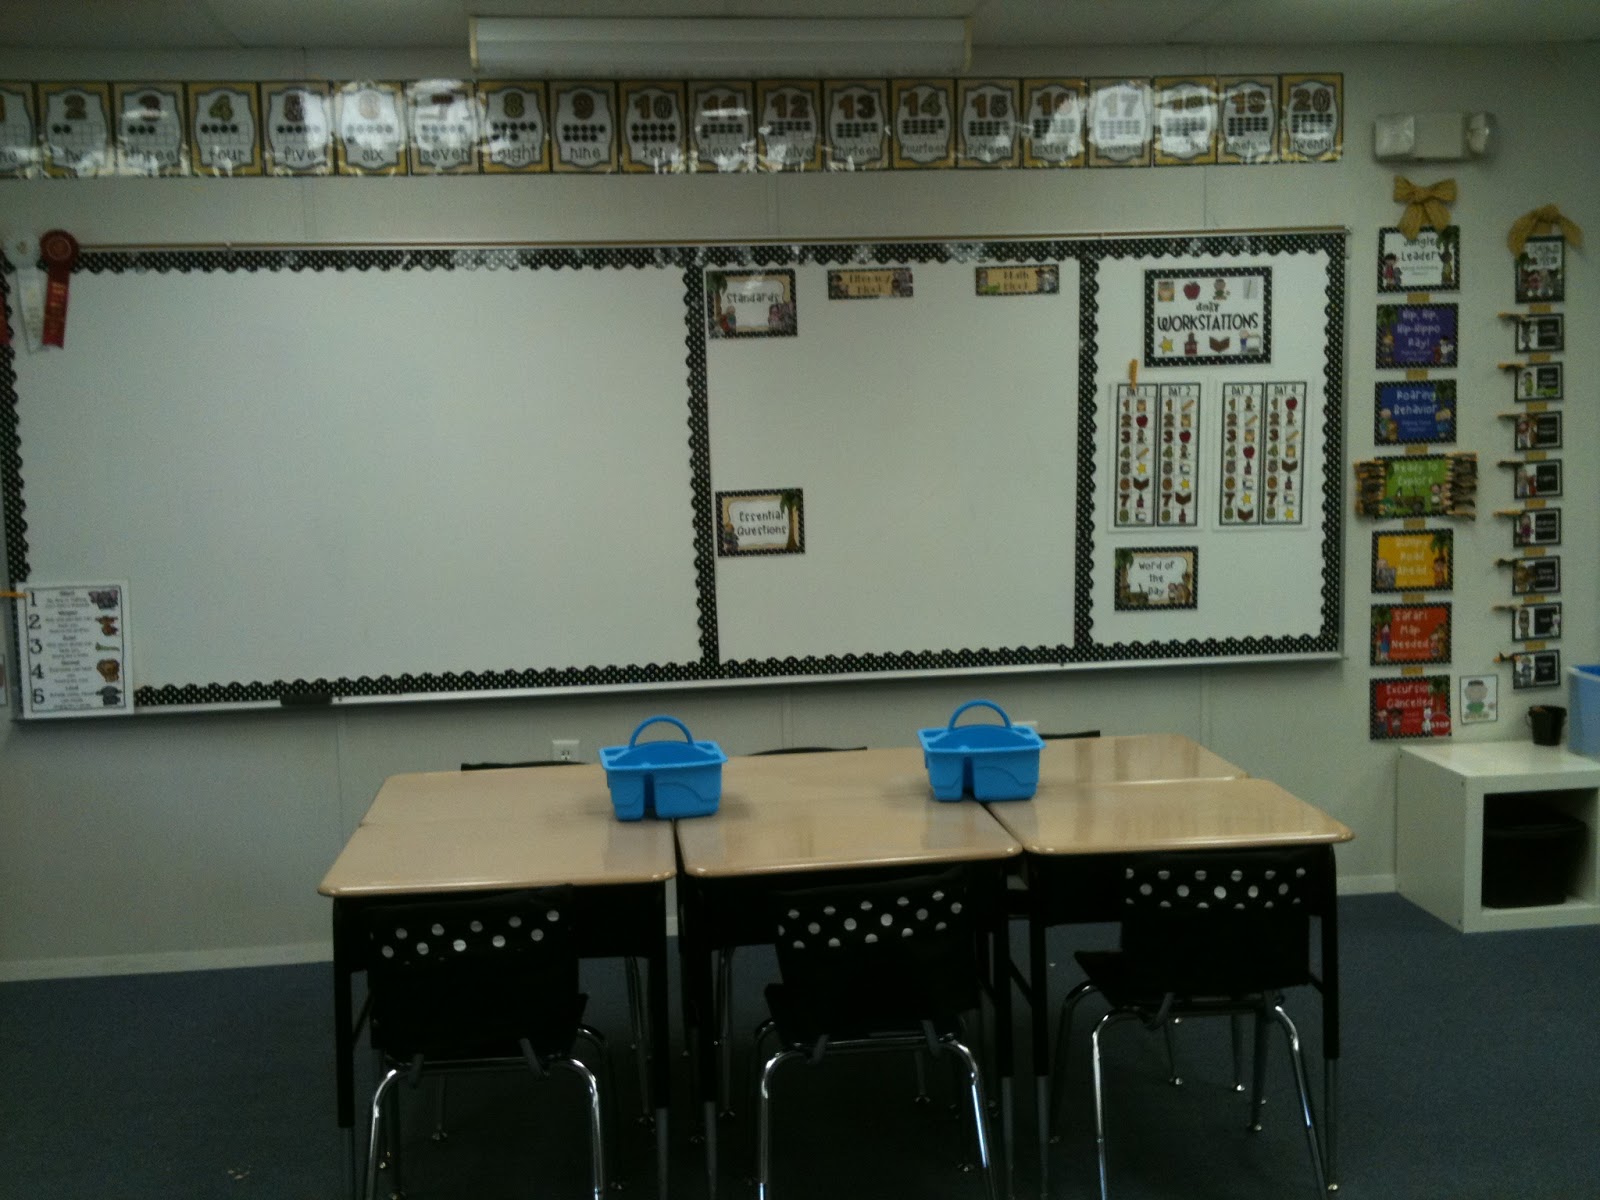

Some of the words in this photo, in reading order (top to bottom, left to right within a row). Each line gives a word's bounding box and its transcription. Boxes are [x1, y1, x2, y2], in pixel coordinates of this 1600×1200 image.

[64, 94, 87, 121] 2
[209, 94, 234, 121] 4
[503, 92, 525, 119] 8
[572, 93, 595, 121] 9
[633, 94, 673, 120] 10
[702, 95, 739, 121] 11
[770, 93, 810, 119] 12
[838, 94, 876, 120] 13
[903, 91, 942, 117] 14
[971, 93, 1009, 118] 15
[1103, 93, 1139, 117] 17
[1292, 89, 1332, 113] 20
[1401, 250, 1436, 262] Leader
[1157, 312, 1260, 332] WORKSTATIONS
[1121, 430, 1131, 444] 3
[1163, 429, 1173, 444] 3
[1226, 428, 1237, 443] 3
[1269, 428, 1279, 442] 3
[1120, 445, 1131, 459] 4
[1162, 445, 1173, 459] 4
[1225, 444, 1236, 458] 4
[1268, 444, 1279, 458] 4
[1119, 492, 1130, 507] 7
[1162, 492, 1172, 507] 7
[1224, 491, 1234, 506] 7
[1267, 491, 1277, 506] 7
[739, 510, 785, 522] Essential
[737, 524, 787, 537] Questions
[29, 591, 38, 608] 1
[29, 613, 41, 630] 2
[30, 638, 43, 655] 3
[30, 663, 44, 680] 4
